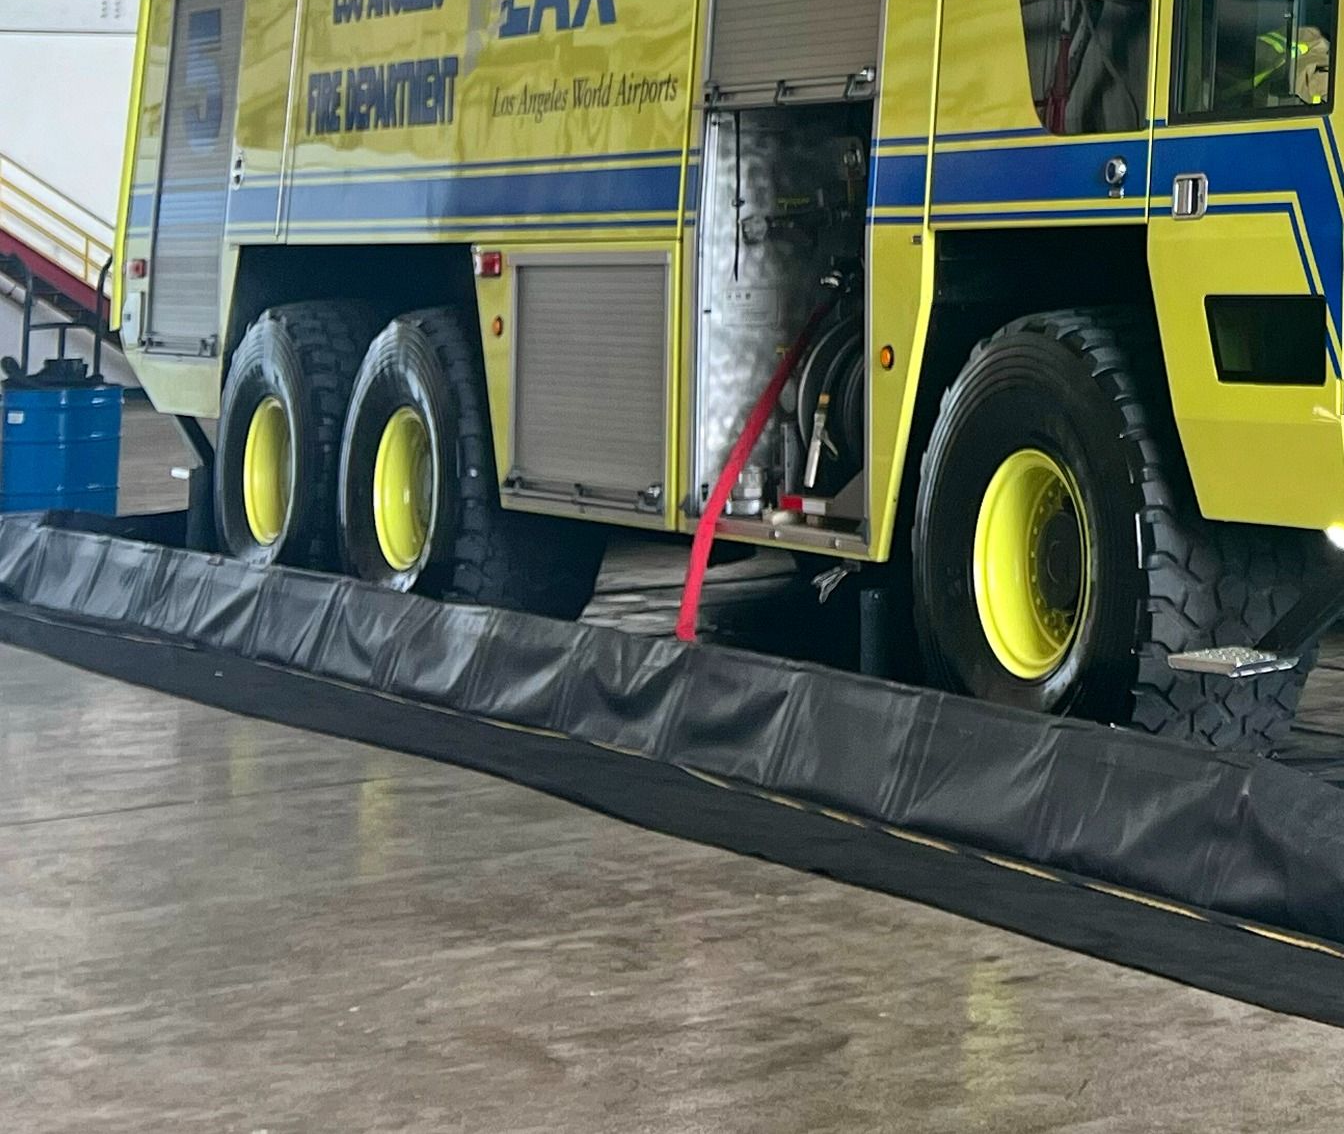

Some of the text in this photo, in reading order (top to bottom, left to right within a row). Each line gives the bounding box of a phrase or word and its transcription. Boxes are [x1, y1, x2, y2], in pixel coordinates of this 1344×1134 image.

[183, 8, 223, 154] 5
[306, 56, 459, 136] FIRE DEPARTMENT
[492, 72, 680, 124] Los Angeles World Airports
